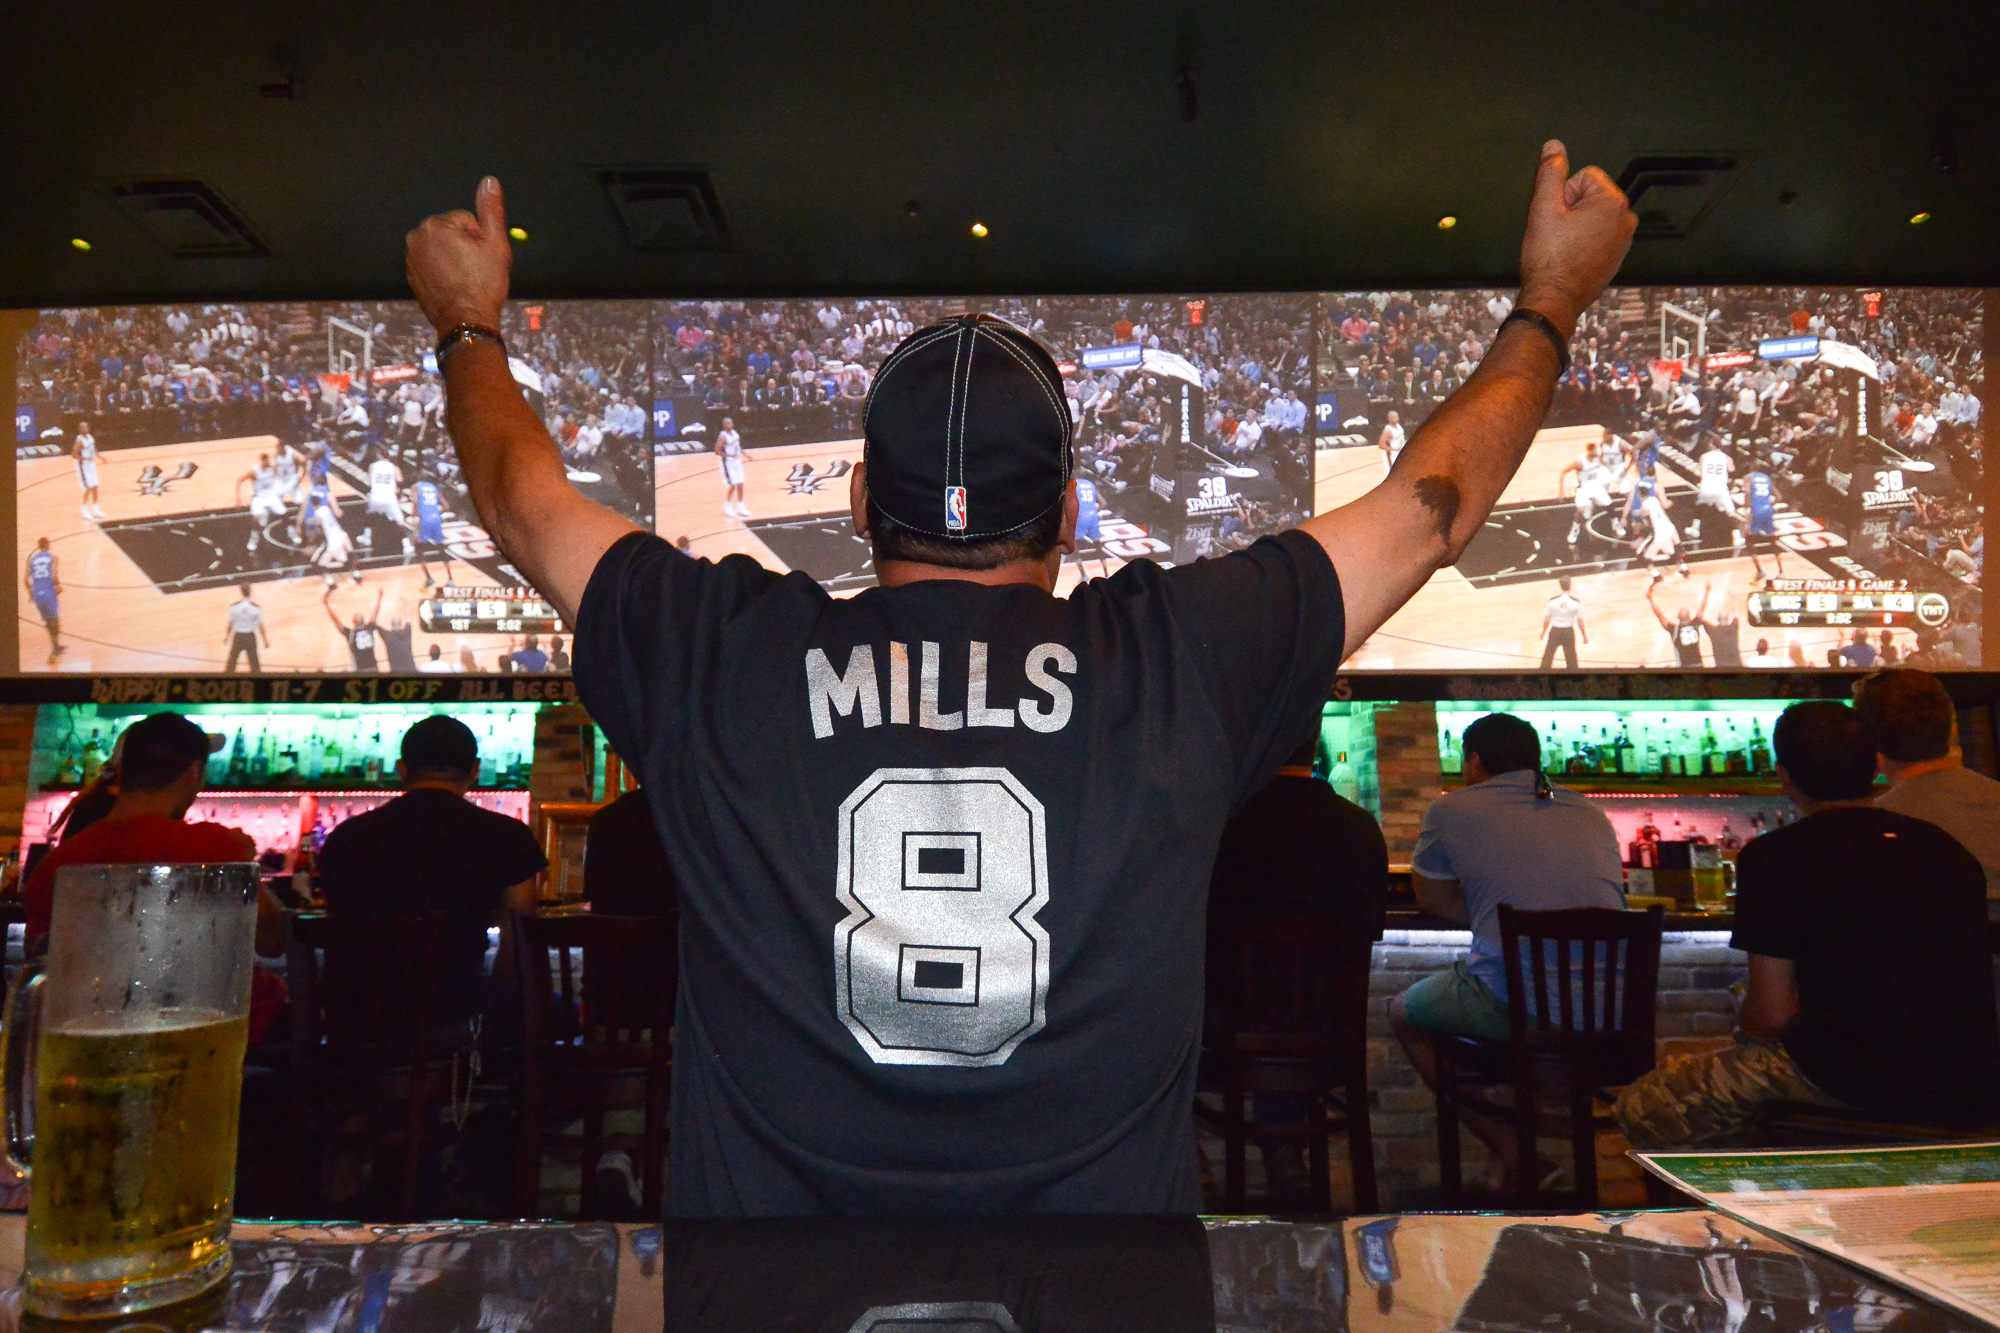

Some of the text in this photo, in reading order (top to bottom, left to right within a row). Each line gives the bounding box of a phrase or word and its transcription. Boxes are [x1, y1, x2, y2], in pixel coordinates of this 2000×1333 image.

[1706, 463, 1723, 475] 22
[1080, 489, 1094, 502] 35
[1862, 487, 1917, 507] SPALDIN
[1186, 494, 1239, 512] SPALDIN
[1773, 579, 1907, 591] WEST FINALS GAME 2
[443, 587, 473, 599] WEST
[474, 587, 514, 599] FINALS
[1852, 596, 1873, 609] SA
[522, 603, 543, 617] SA
[1779, 612, 1800, 624] 1ST
[451, 619, 471, 631] 1ST
[388, 680, 442, 701] OFF
[459, 680, 505, 701] ALL
[805, 640, 1078, 739] MILLS
[833, 767, 1050, 1067] 8
